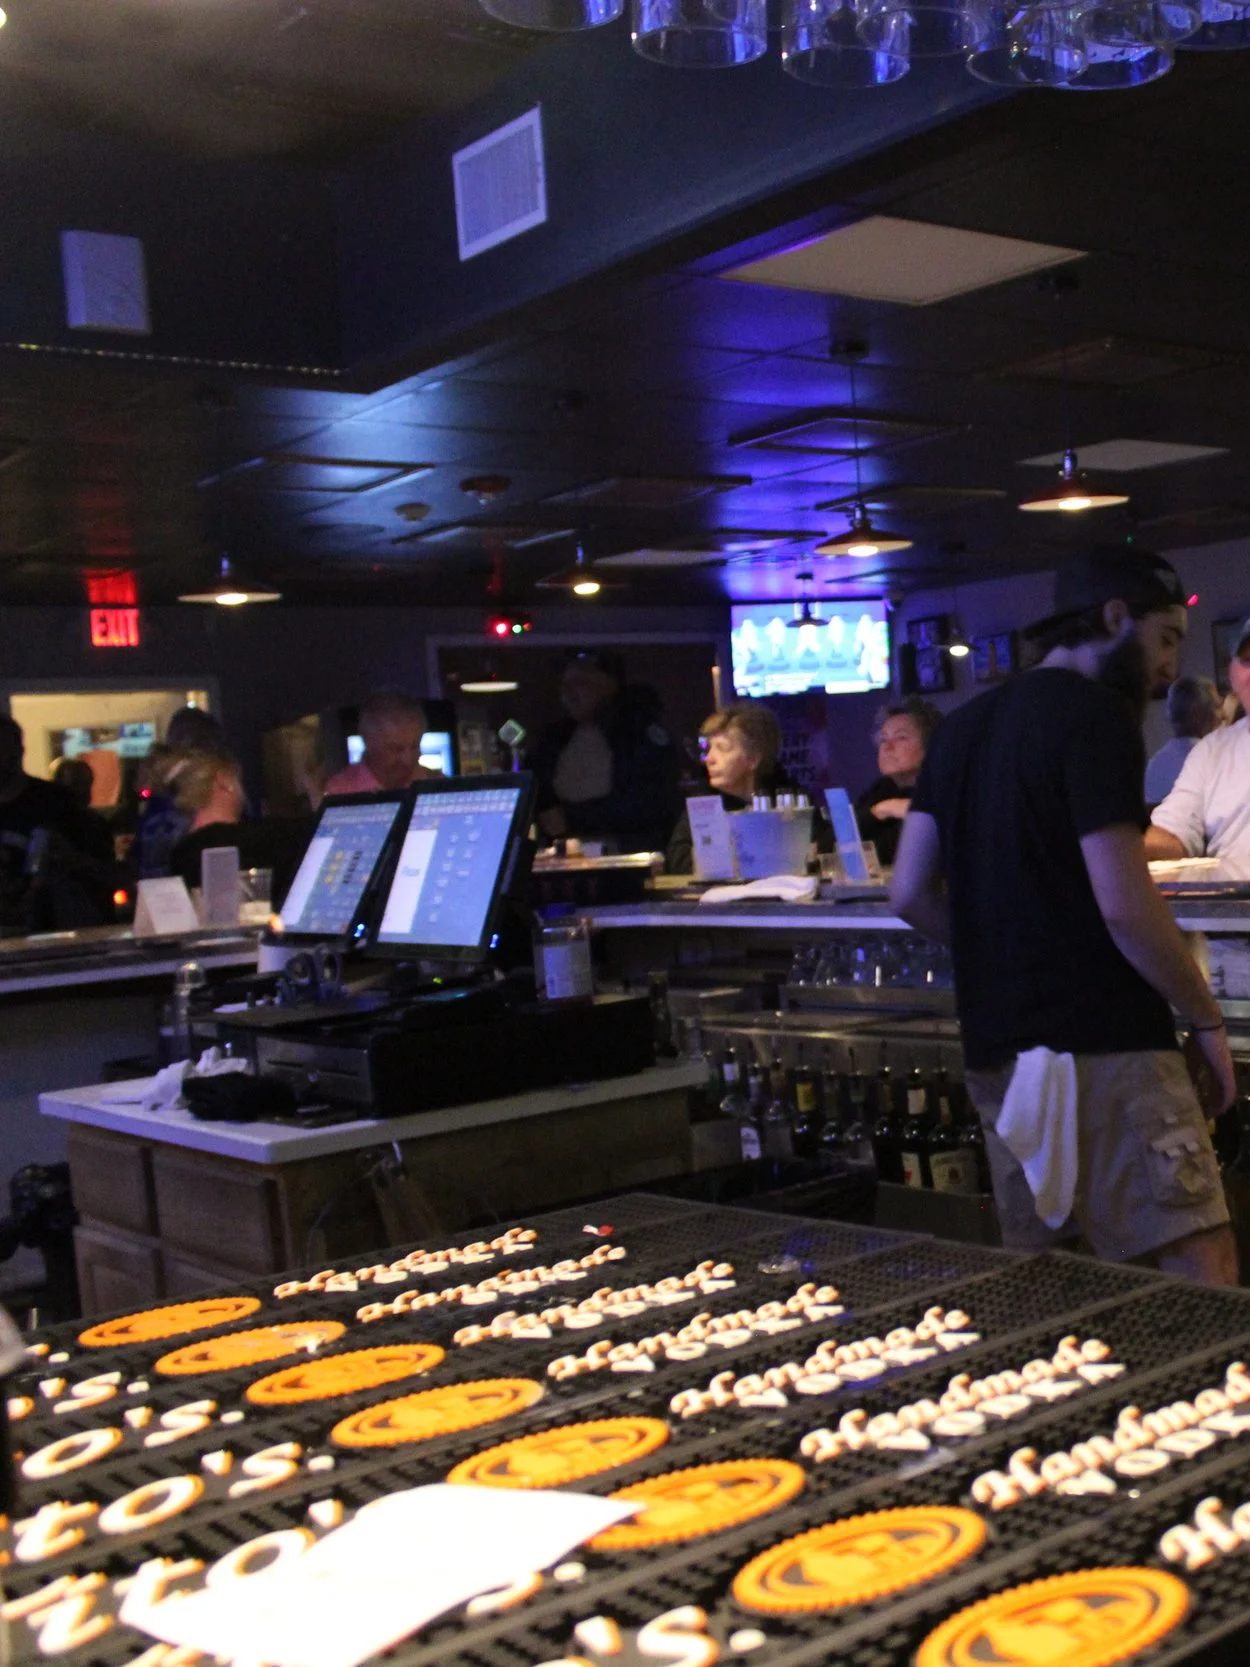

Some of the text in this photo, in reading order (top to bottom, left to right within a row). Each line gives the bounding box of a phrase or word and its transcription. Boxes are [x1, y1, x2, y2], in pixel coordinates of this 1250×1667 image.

[90, 608, 140, 647] EXIT
[513, 1279, 737, 1339] VODKA
[547, 1282, 840, 1381] Handmade
[611, 1304, 845, 1372] VODKA
[669, 1306, 971, 1418] Handmade
[739, 1332, 982, 1409] VODKA
[800, 1335, 1111, 1463] Handmade
[876, 1363, 1127, 1451] VODKA
